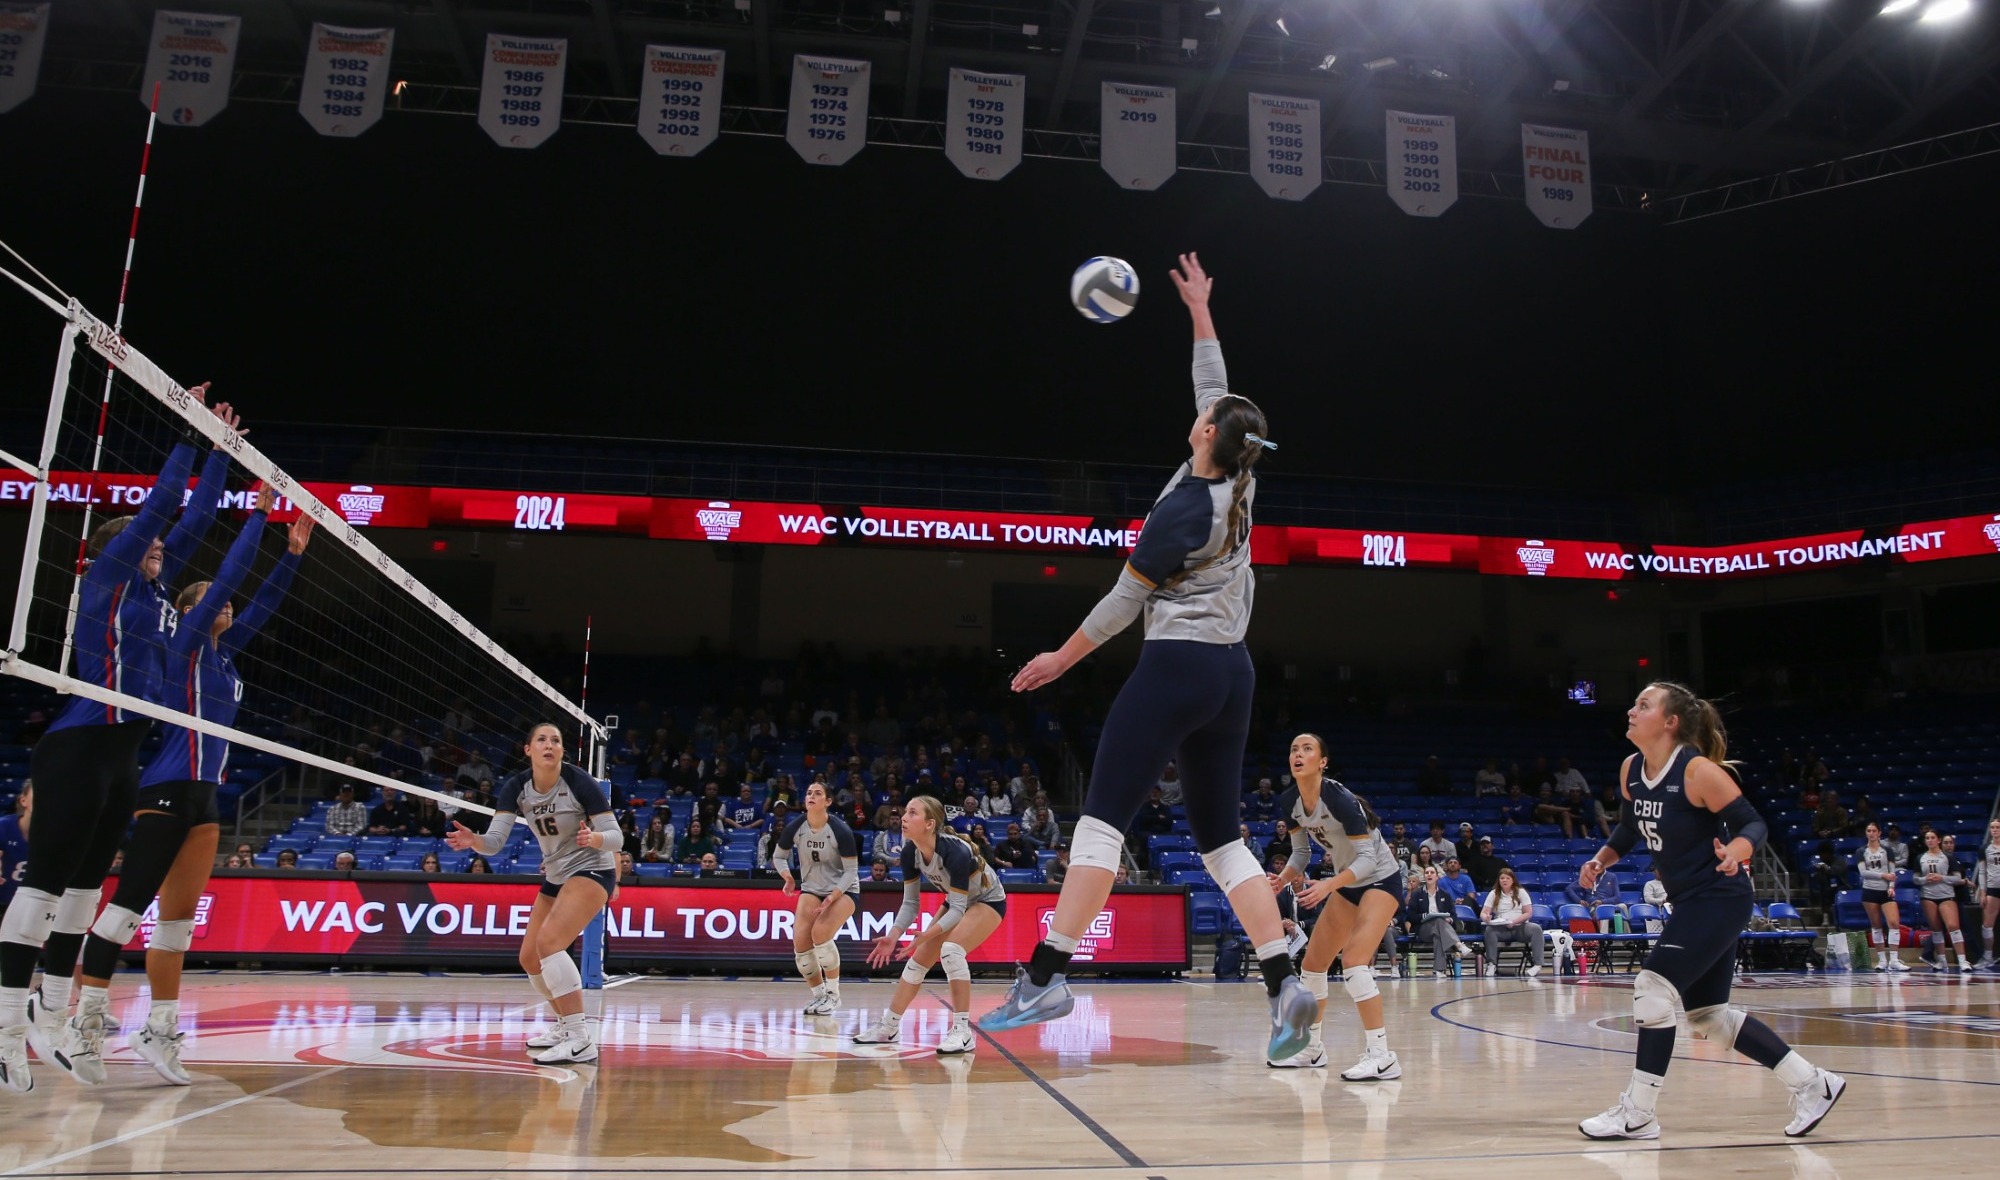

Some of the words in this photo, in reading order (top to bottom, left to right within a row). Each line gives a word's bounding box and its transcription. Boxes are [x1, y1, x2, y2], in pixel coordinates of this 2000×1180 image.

[501, 40, 555, 51] VOLLEYBALL
[169, 54, 212, 68] 2016
[659, 51, 713, 62] VOLLEYBALL
[328, 58, 368, 72] 1982
[807, 61, 859, 73] VOLLEYBALL
[167, 69, 210, 83] 2018
[327, 74, 367, 88] 1983
[504, 70, 544, 82] 1986
[963, 74, 1013, 87] VOLLEYBALL
[503, 84, 543, 97] 1987
[661, 79, 703, 91] 1990
[812, 84, 849, 97] 1973
[323, 89, 365, 103] 1984
[1115, 87, 1164, 98] VOLLEYBALL
[501, 99, 541, 112] 1988
[661, 93, 701, 107] 1992
[810, 98, 848, 111] 1974
[967, 99, 1004, 112] 1978
[1261, 99, 1309, 110] VOLLEYBALL
[322, 104, 362, 117] 1985
[659, 108, 700, 121] 1998
[1120, 110, 1157, 123] 2019
[499, 113, 540, 127] 1989
[809, 113, 846, 126] 1975
[967, 112, 1004, 126] 1979
[1397, 116, 1445, 127] VOLLEYBALL
[657, 122, 699, 136] 2002
[965, 126, 1004, 140] 1980
[1268, 121, 1303, 134] 1985
[808, 128, 846, 141] 1976
[1267, 134, 1303, 148] 1986
[966, 140, 1002, 154] 1981
[1403, 140, 1438, 150] 1989
[1267, 149, 1303, 162] 1987
[1403, 153, 1439, 165] 1990
[1525, 145, 1586, 165] FINAL
[1267, 163, 1303, 176] 1988
[1404, 166, 1439, 179] 2001
[1528, 165, 1585, 184] FOUR
[1404, 180, 1440, 192] 2002
[1542, 187, 1573, 201] 1989
[337, 494, 384, 512] WAC
[514, 495, 565, 530] 2024
[696, 510, 742, 528] WAC
[778, 514, 838, 534] WAC
[843, 517, 994, 541] VOLLEYBALL
[1000, 524, 1142, 547] TOURNAME
[1363, 534, 1406, 567] 2024
[1516, 548, 1554, 564] WAC
[1585, 552, 1634, 570] WAC
[1638, 552, 1770, 574] VOLLEYBALL
[1774, 531, 1945, 566] TOURNAMENT
[533, 803, 556, 815] CBU
[1634, 799, 1664, 819] CBU
[534, 817, 559, 836] 16
[1637, 820, 1663, 851] 15
[807, 840, 825, 849] CBU
[811, 850, 820, 862] 8
[1929, 864, 1937, 873] 11
[280, 900, 385, 933] WAC
